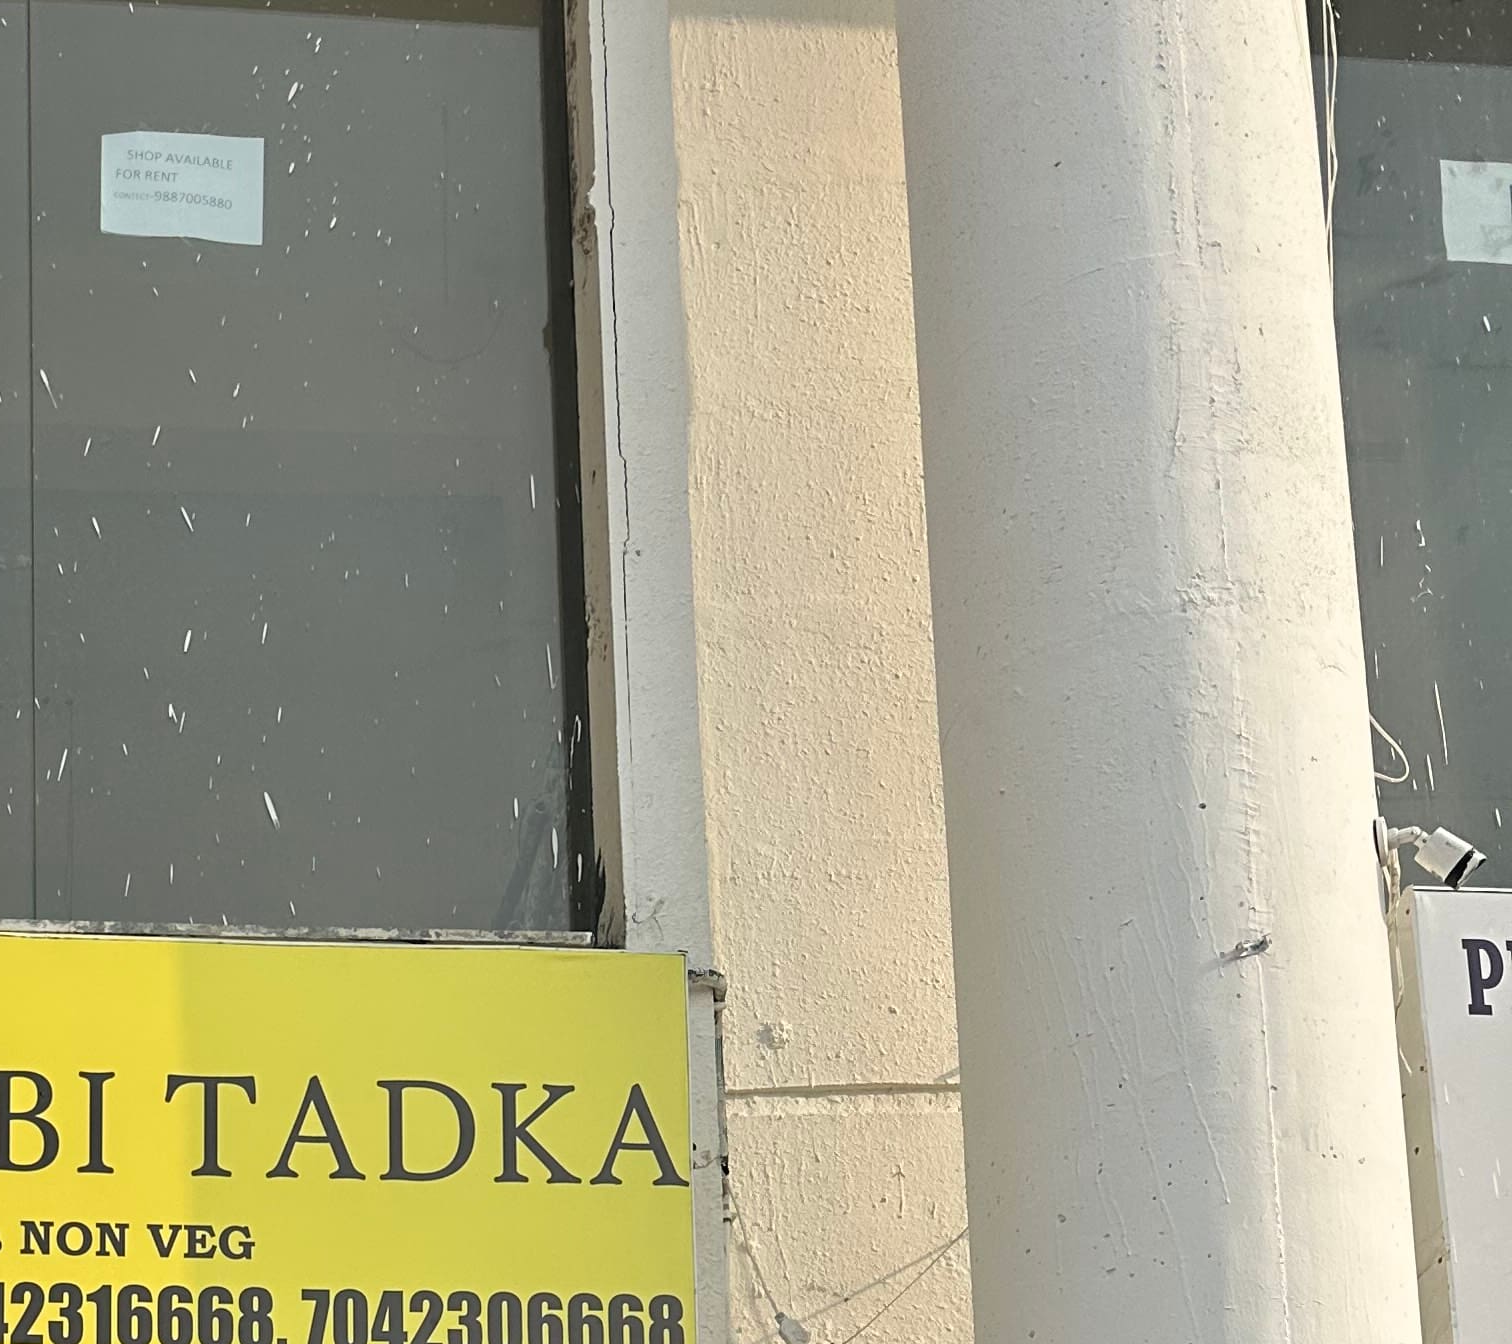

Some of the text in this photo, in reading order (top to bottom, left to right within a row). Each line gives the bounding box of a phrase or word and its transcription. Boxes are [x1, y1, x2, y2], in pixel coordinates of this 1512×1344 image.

[114, 168, 178, 183] FOR RENT
[127, 149, 233, 170] SHOP AVAILABLE
[1460, 938, 1512, 1016] P
[163, 1074, 690, 1188] TADKA
[19, 1218, 137, 1259] NON
[145, 1222, 257, 1263] VEG
